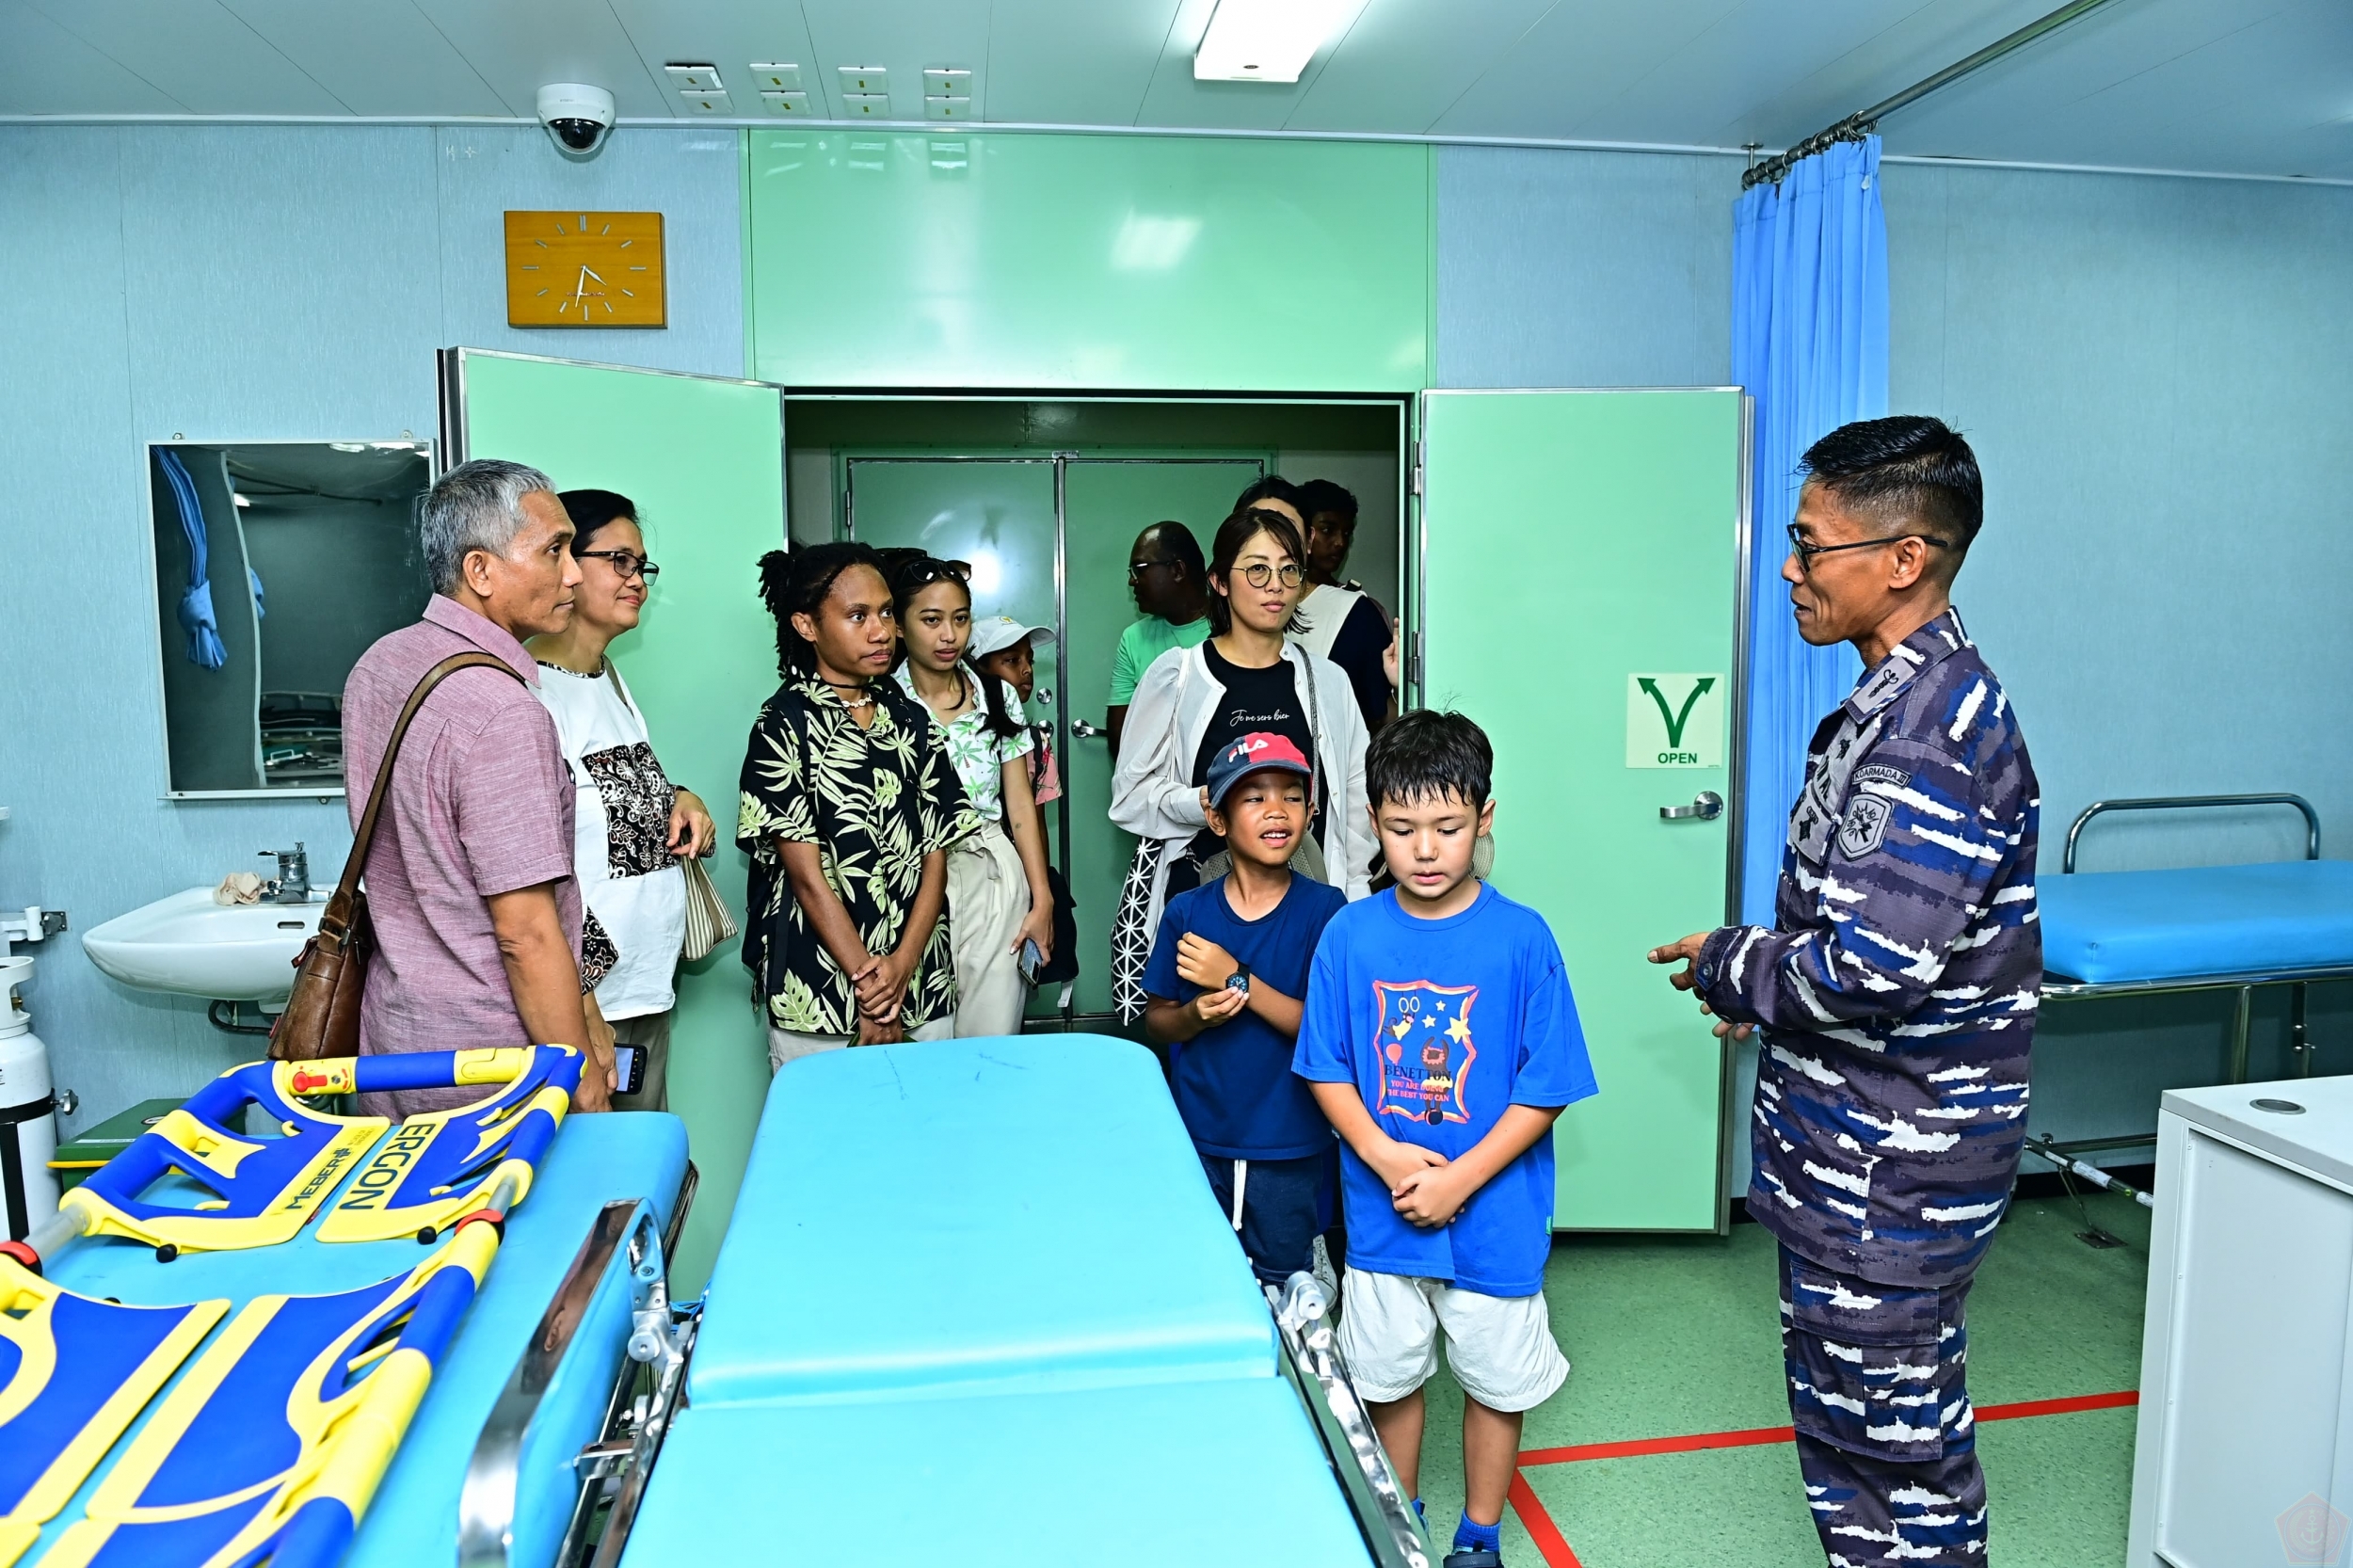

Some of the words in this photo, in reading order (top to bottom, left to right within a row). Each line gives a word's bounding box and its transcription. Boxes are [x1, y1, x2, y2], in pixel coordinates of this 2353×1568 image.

[1230, 709, 1247, 727] Je
[1228, 739, 1269, 762] FILA
[1657, 753, 1697, 763] OPEN
[1854, 766, 1897, 780] KOARMADA
[1385, 1064, 1451, 1080] BENETTON
[1401, 1090, 1417, 1098] BEST
[339, 1124, 437, 1209] ERGON
[285, 1159, 344, 1209] MEBER
